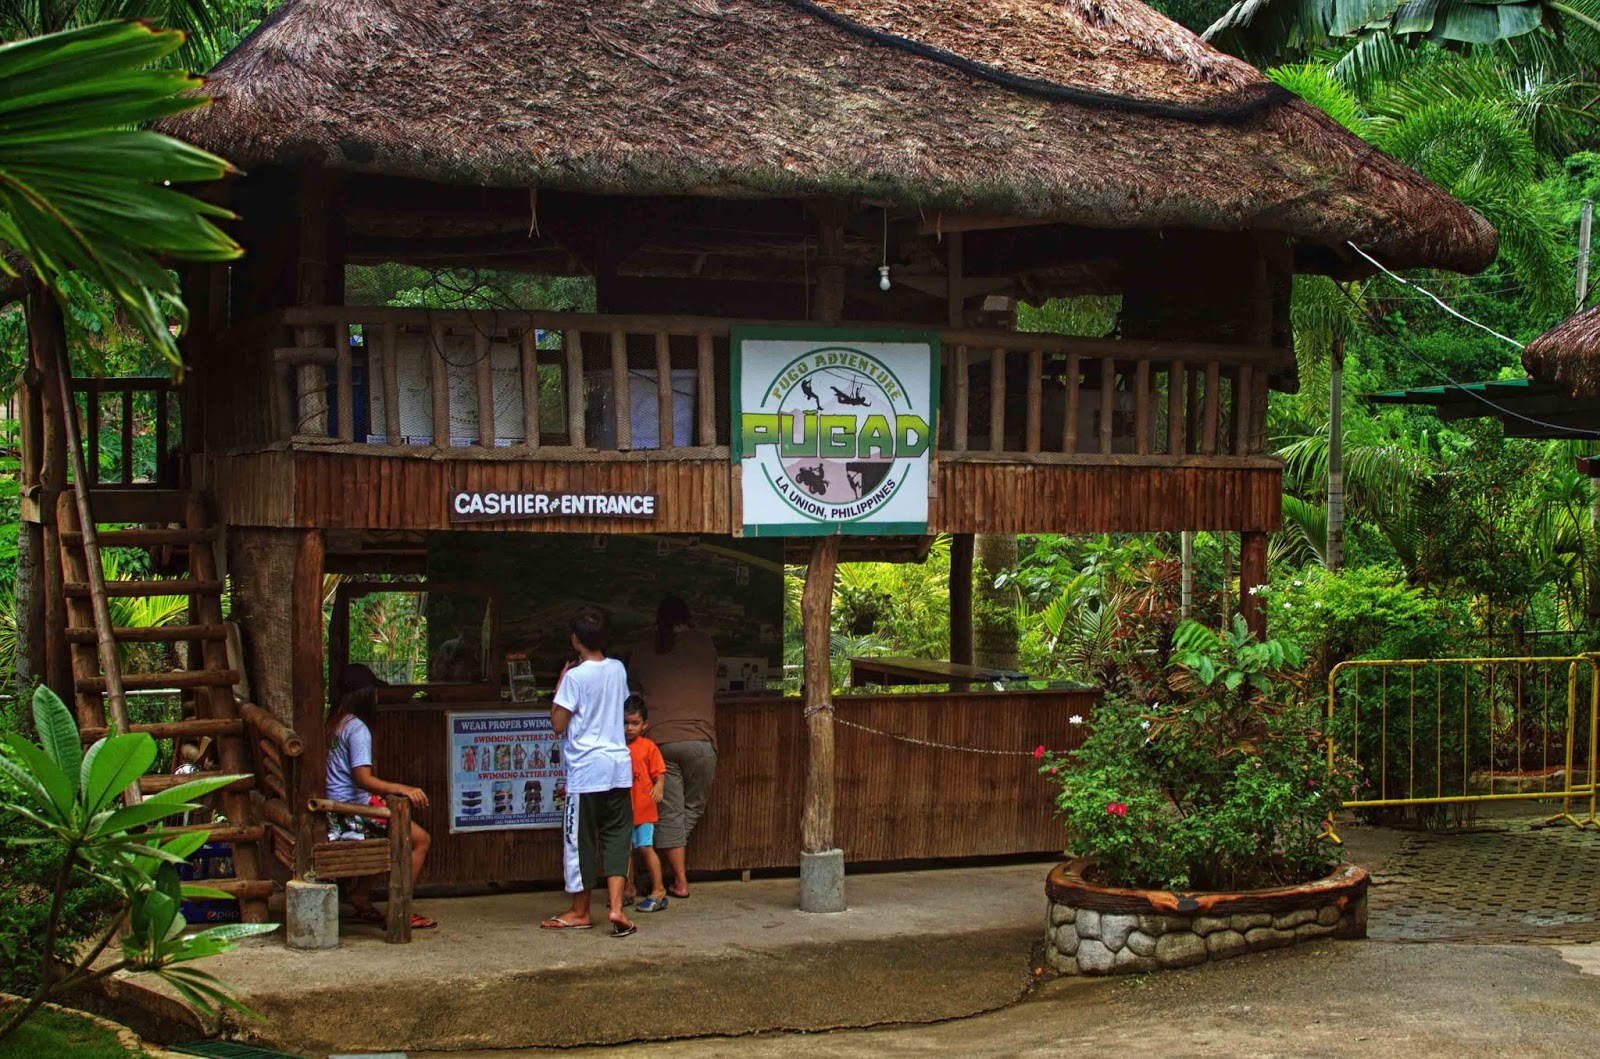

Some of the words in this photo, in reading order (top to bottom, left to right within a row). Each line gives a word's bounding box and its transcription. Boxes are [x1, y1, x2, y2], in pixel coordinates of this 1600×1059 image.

[771, 360, 809, 400] PUGO
[815, 352, 903, 402] ADVENTURE
[741, 410, 930, 459] PUGAD
[454, 492, 548, 515] CASHIER
[561, 494, 655, 515] ENTRANCE
[775, 475, 788, 495] LA
[789, 491, 828, 519] UNION,
[831, 478, 897, 519] PHILIPPINES
[461, 721, 487, 731] WEAR
[488, 720, 520, 730] PROPER
[523, 719, 552, 729] SWIMM
[474, 734, 514, 743] SWIMMING
[516, 733, 543, 742] ATTIRE
[545, 733, 560, 741] FOR
[478, 770, 518, 780] SWIMMING
[519, 769, 546, 778] ATTIRE
[548, 769, 563, 777] FOR
[217, 910, 239, 920] pep
